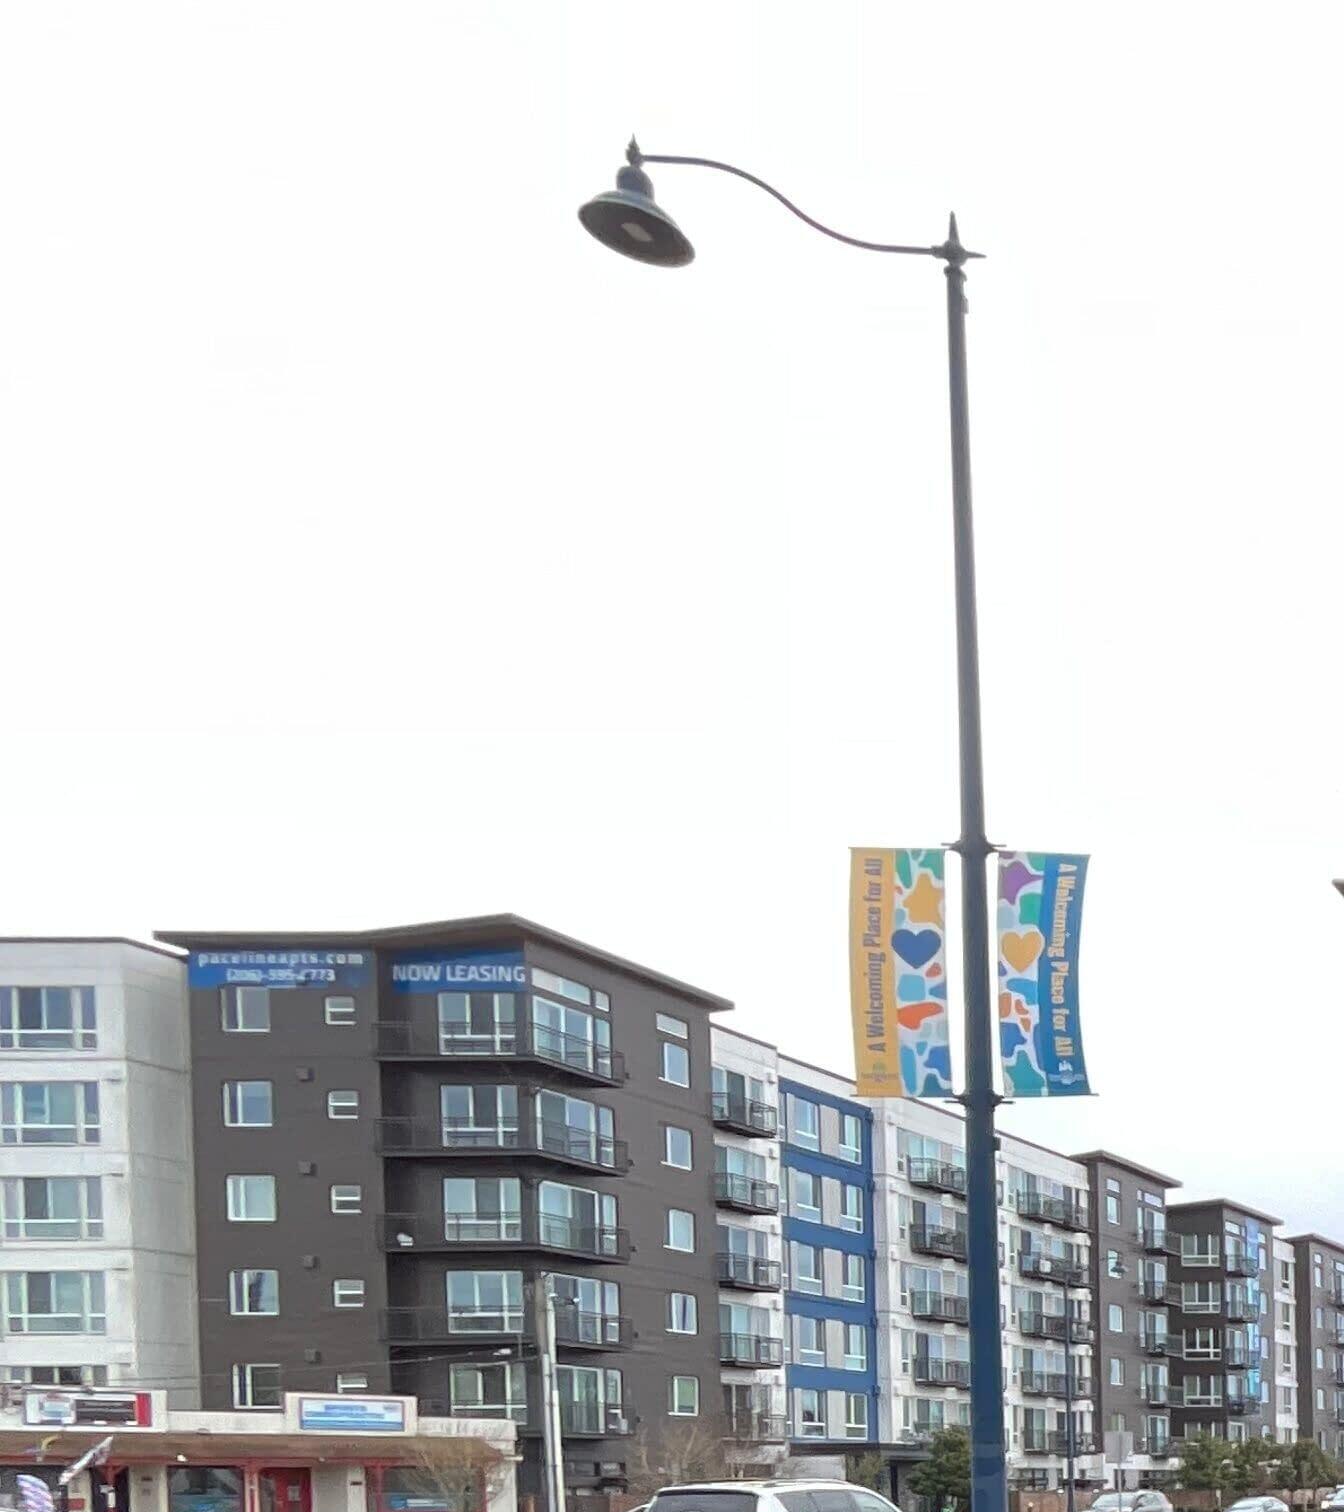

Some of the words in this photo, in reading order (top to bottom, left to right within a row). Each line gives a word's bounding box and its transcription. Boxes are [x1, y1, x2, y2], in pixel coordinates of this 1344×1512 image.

[864, 858, 883, 880] All
[1058, 863, 1077, 873] A
[863, 881, 882, 903] for
[863, 906, 882, 948] Place
[1048, 875, 1075, 958] Welcoming
[392, 964, 441, 982] NOW
[446, 965, 526, 983] LEASING
[1051, 961, 1069, 1005] Place
[863, 950, 886, 1033] Welcoming
[1052, 1008, 1071, 1031] for
[867, 1034, 885, 1052] A
[1055, 1036, 1073, 1057] All
